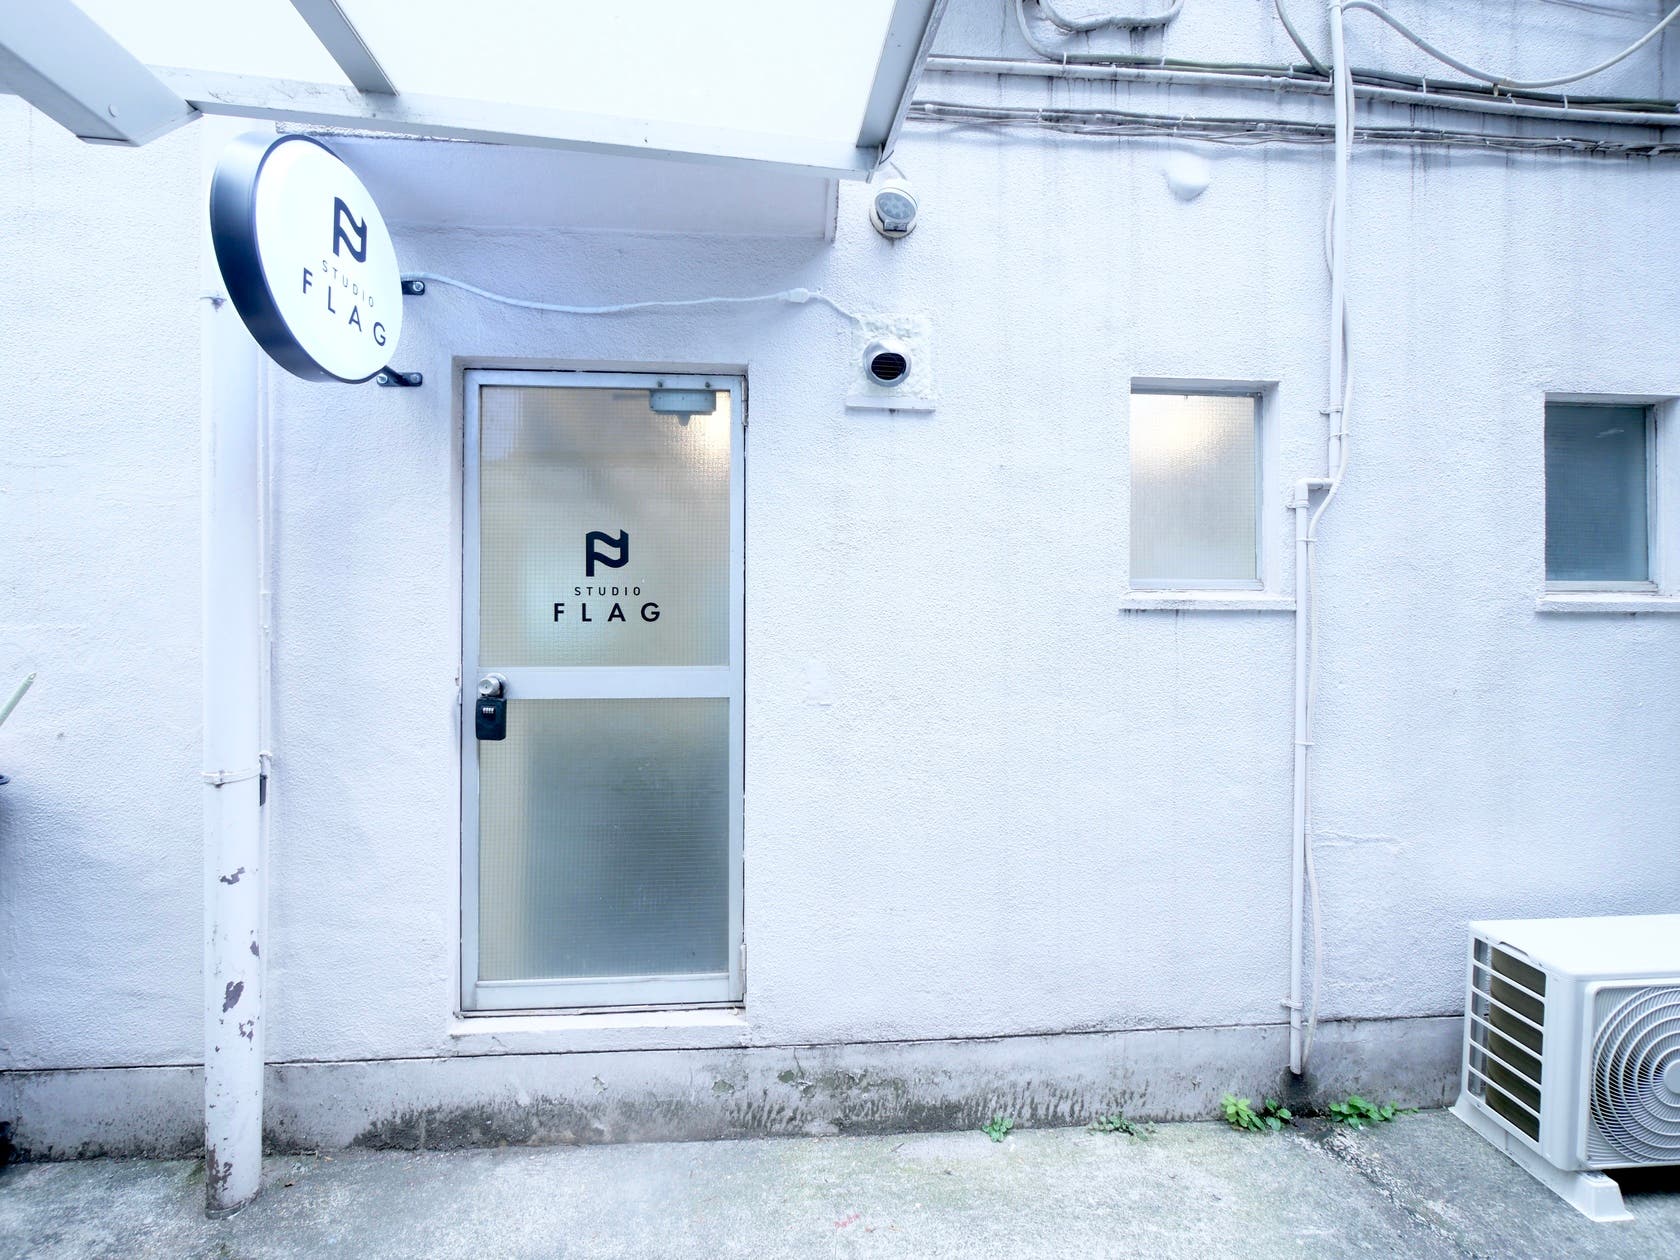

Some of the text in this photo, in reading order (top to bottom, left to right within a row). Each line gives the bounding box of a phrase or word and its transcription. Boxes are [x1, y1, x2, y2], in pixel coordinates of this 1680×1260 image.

[322, 260, 374, 307] STUDIO
[303, 267, 386, 346] FLAG
[574, 586, 641, 596] STUDIO
[554, 602, 660, 622] FLAG
